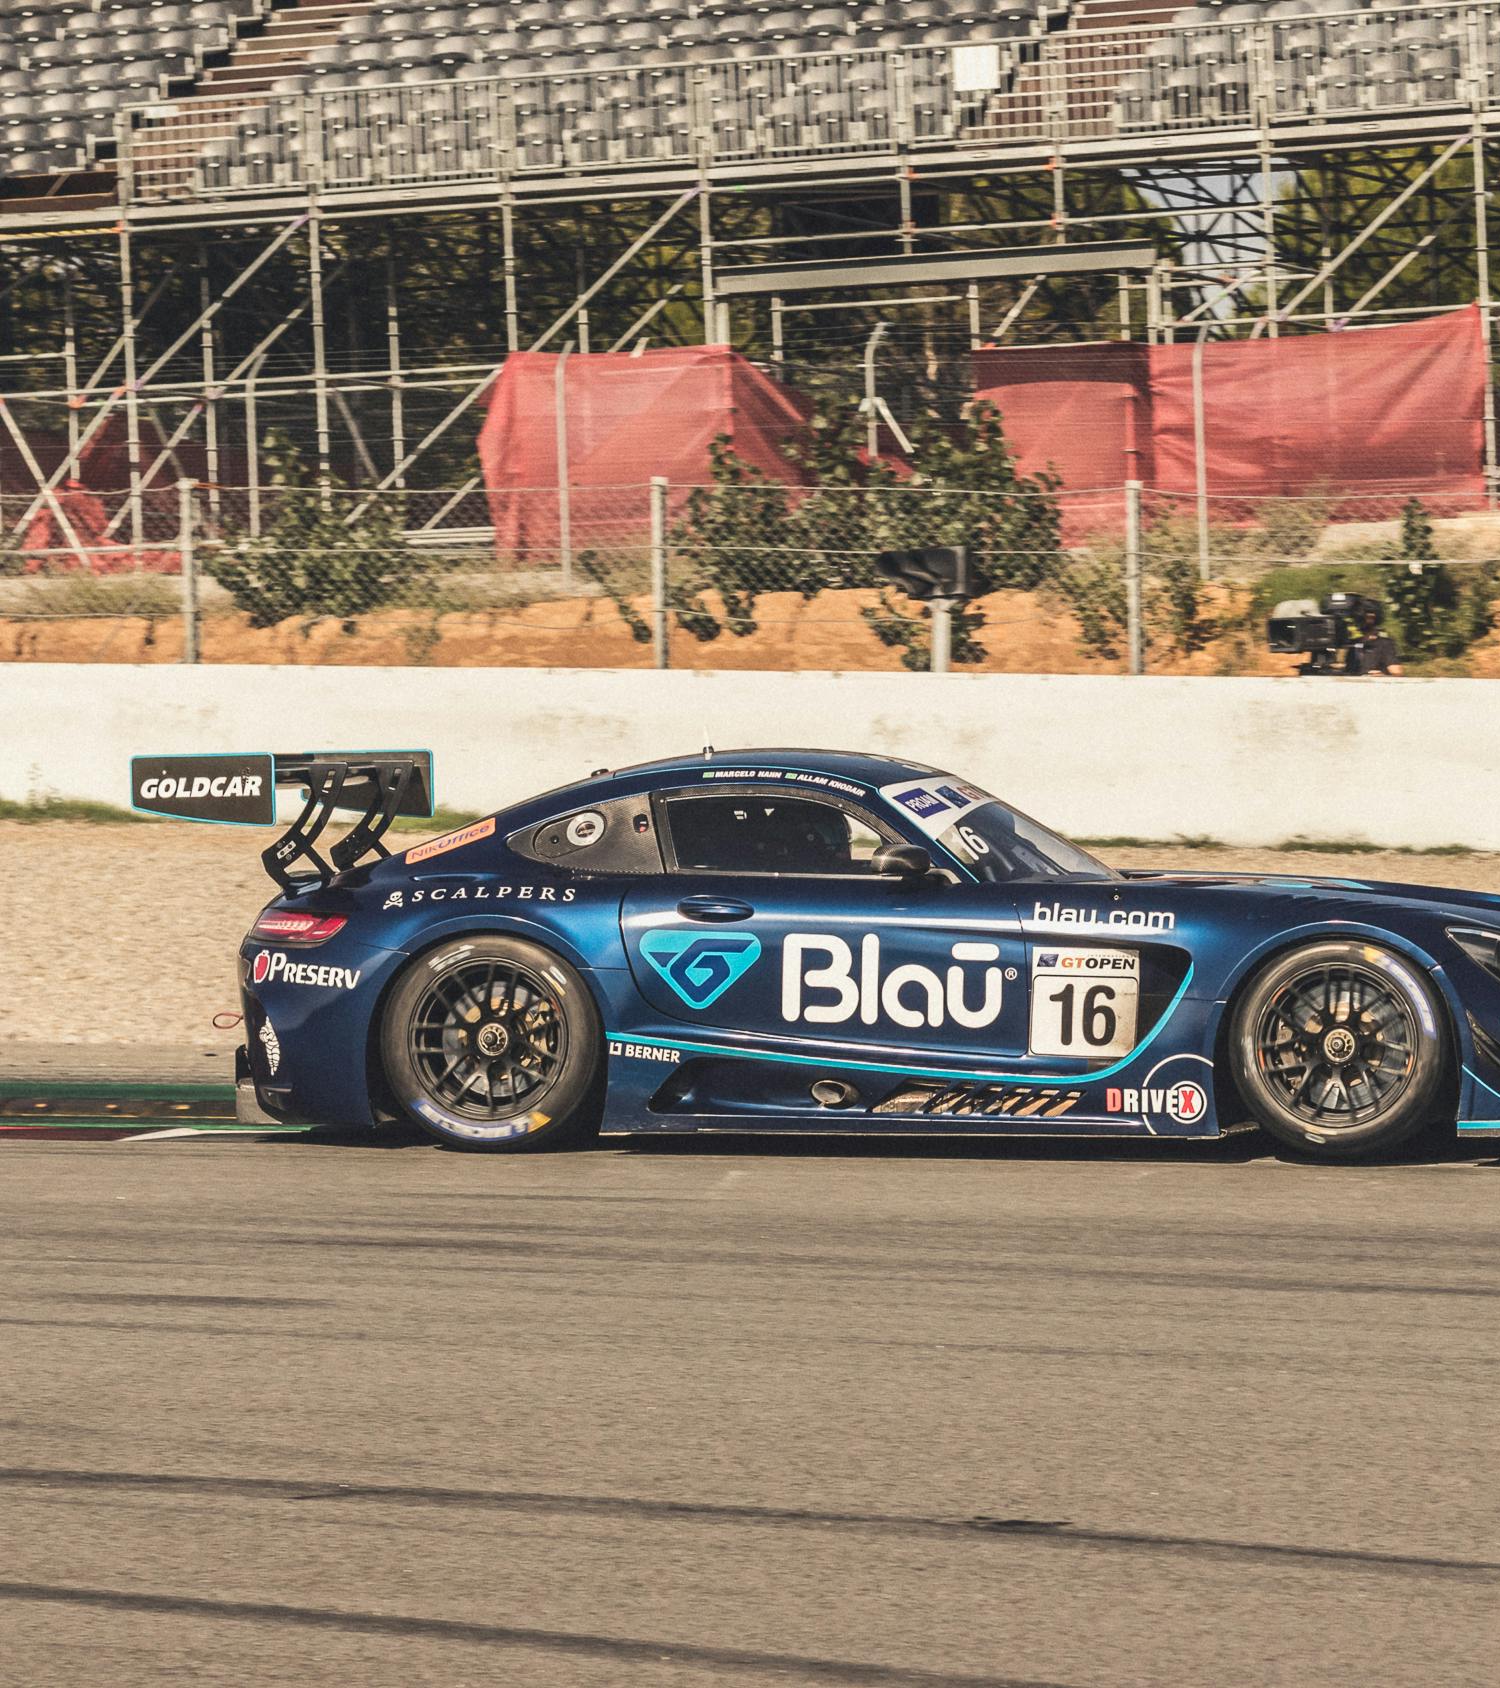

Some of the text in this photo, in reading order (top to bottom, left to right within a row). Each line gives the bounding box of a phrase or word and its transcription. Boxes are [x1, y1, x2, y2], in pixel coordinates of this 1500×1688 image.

[714, 770, 756, 779] MARCELO
[796, 774, 866, 797] ALLAM KHODAIR
[140, 775, 263, 799] GOLDCAR
[411, 886, 576, 903] SCALPERS
[1033, 901, 1176, 929] blau.com
[1049, 983, 1117, 1047] 16
[624, 1043, 681, 1064] BERNER
[1106, 1087, 1196, 1114] DRIVEX
